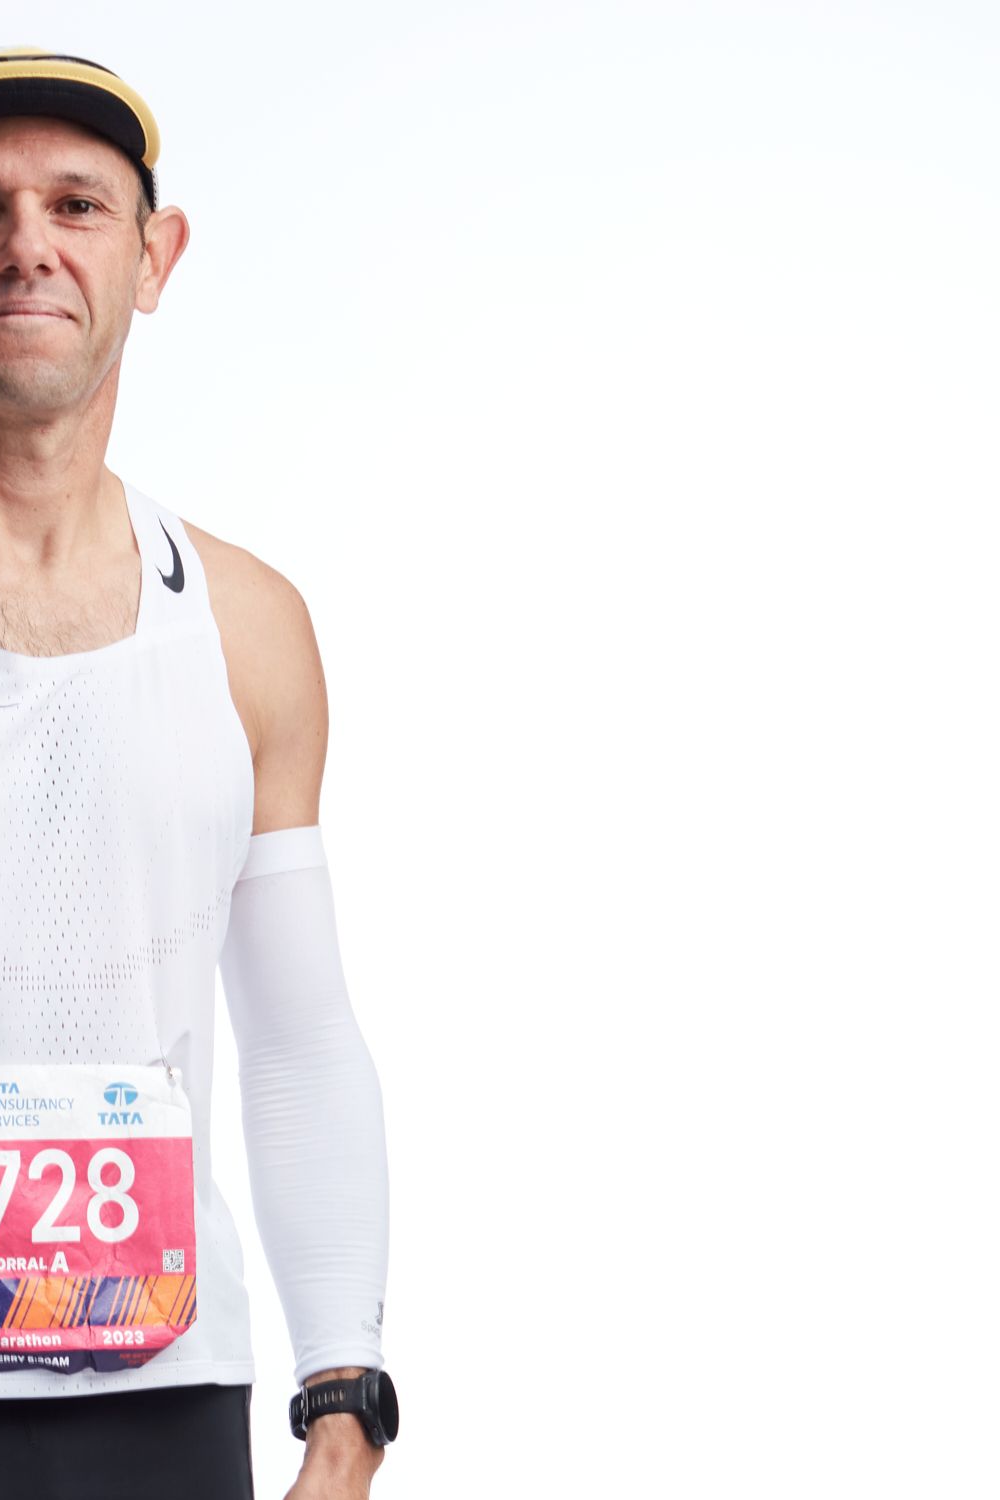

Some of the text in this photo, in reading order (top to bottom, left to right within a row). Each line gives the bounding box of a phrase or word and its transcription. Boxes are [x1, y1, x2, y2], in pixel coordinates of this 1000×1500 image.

[98, 1112, 143, 1125] TATA
[51, 1252, 70, 1273] A
[103, 1331, 145, 1345] 2023
